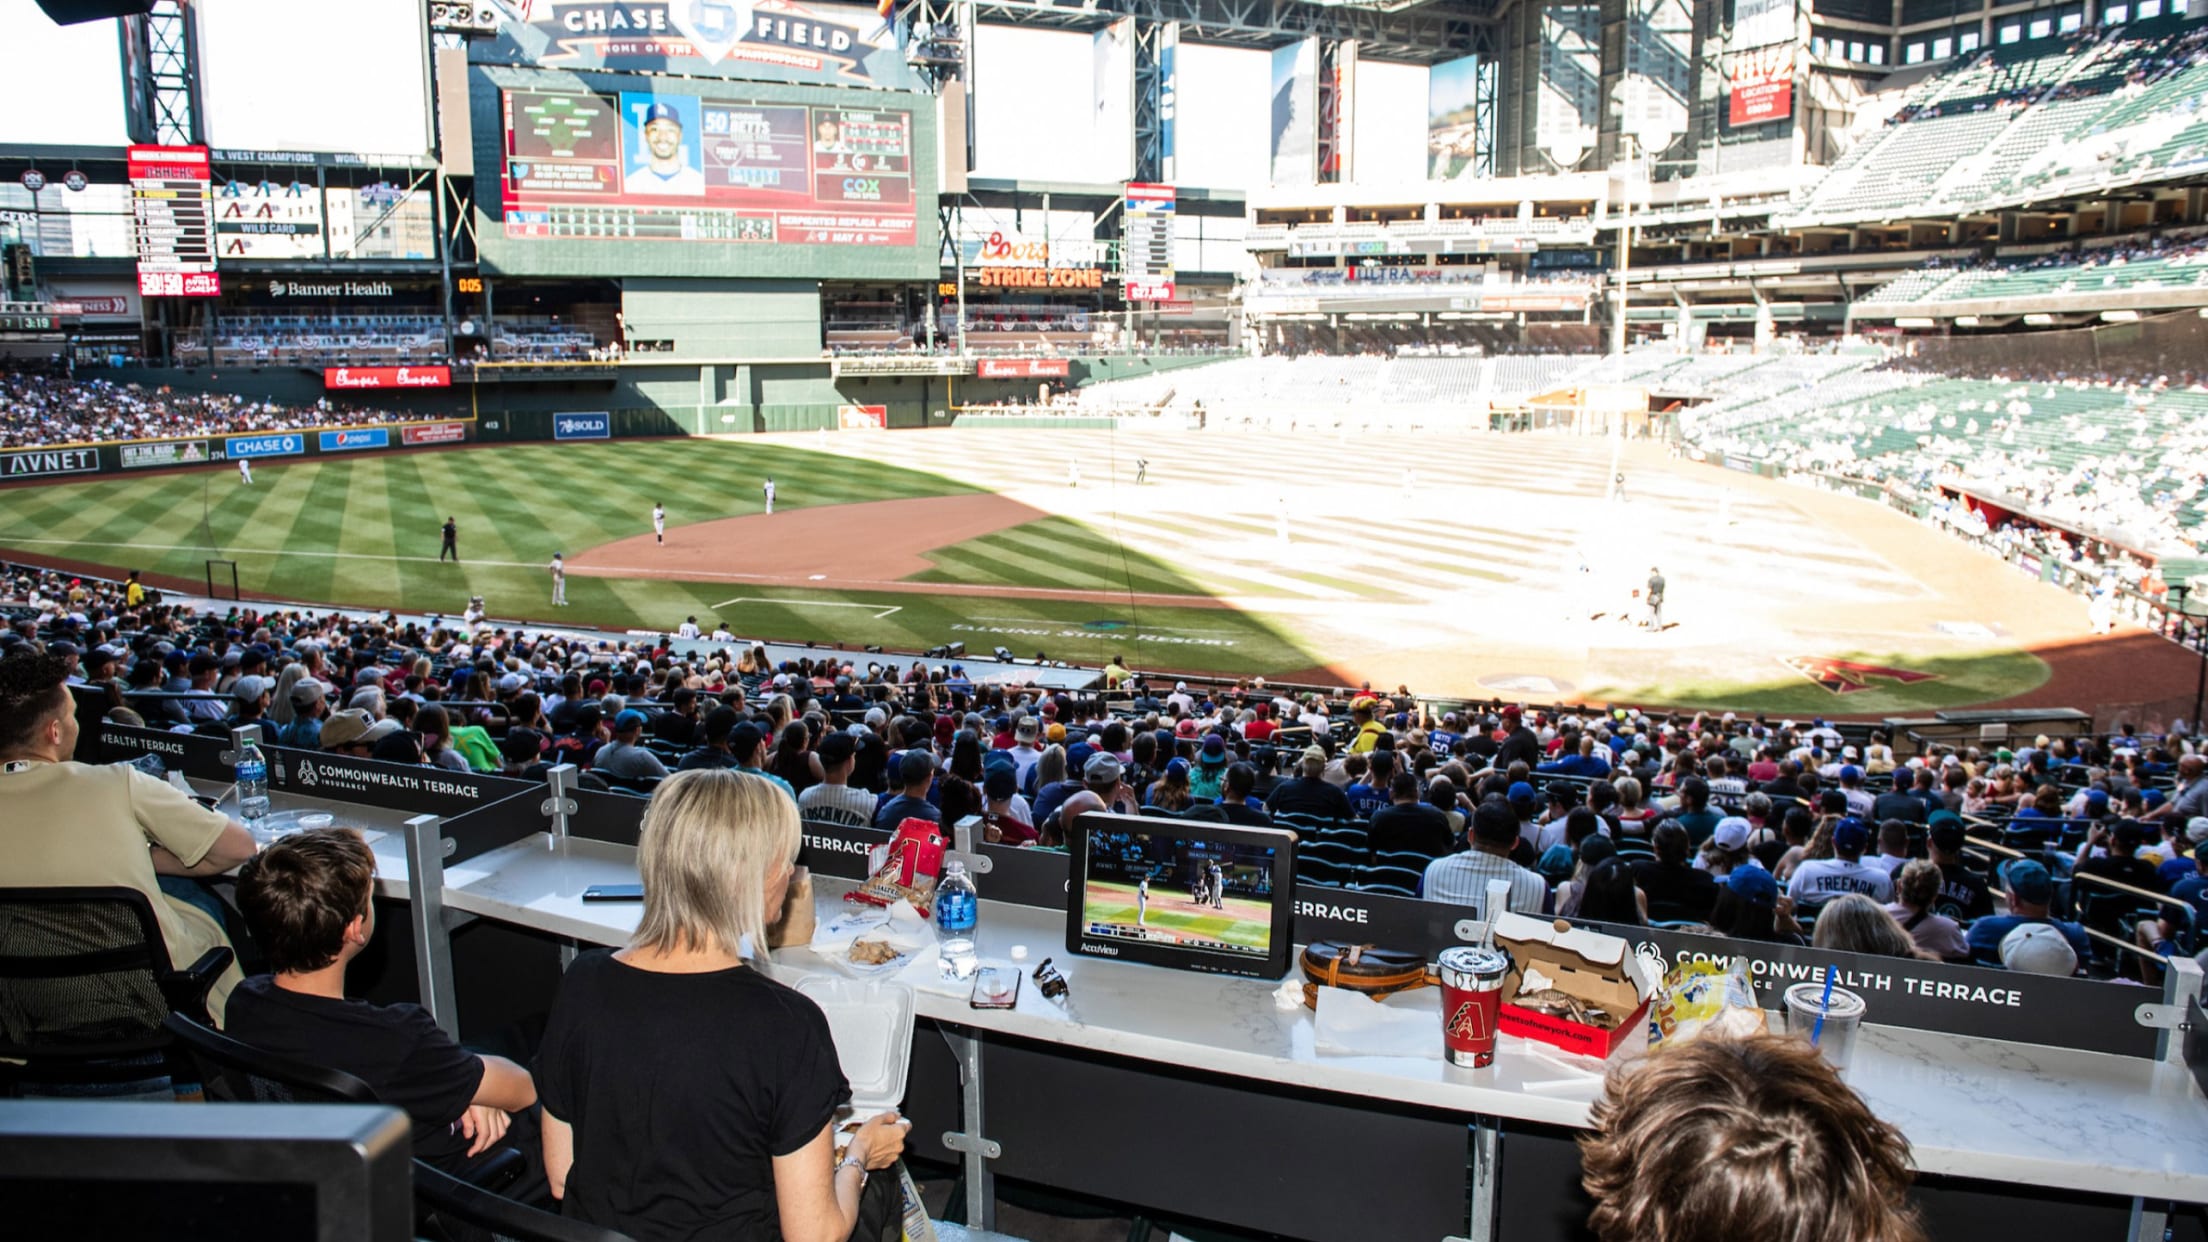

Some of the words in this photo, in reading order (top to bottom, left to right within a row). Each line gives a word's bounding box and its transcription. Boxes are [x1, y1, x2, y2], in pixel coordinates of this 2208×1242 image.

[564, 9, 666, 33] CHASE
[758, 17, 850, 51] FIELD
[601, 44, 637, 54] HOME
[645, 44, 661, 53] OF
[667, 44, 692, 56] THE
[704, 111, 728, 134] 50
[212, 151, 225, 160] NL
[227, 151, 255, 161] WEST
[257, 152, 315, 163] CHAMPIONS
[842, 177, 880, 193] COX
[240, 223, 267, 233] WILD
[269, 224, 296, 234] CARD
[982, 231, 1049, 260] Coors
[979, 267, 1048, 287] STRIKE
[1050, 268, 1102, 288] ZONE
[1357, 267, 1410, 281] ULTRA
[288, 281, 343, 296] Banner
[344, 281, 393, 296] Health
[25, 317, 49, 329] 3:19
[485, 421, 498, 430] 413
[236, 439, 281, 454] CHASE
[349, 433, 371, 445] pepsi
[11, 451, 88, 474] AVNET
[951, 623, 1051, 637] TALKING
[1056, 629, 1128, 641] STICK
[1135, 633, 1241, 647] RESORT
[140, 738, 185, 755] TERRACE
[319, 764, 419, 789] COMMONWEALTH
[423, 780, 479, 798] TERRACE
[321, 779, 367, 791] INSURANCE
[802, 834, 872, 856] TERRACE
[1816, 875, 1876, 898] FREEMAN
[1676, 950, 1892, 991] COMONWEALTH
[1903, 977, 2023, 1007] TERRACE
